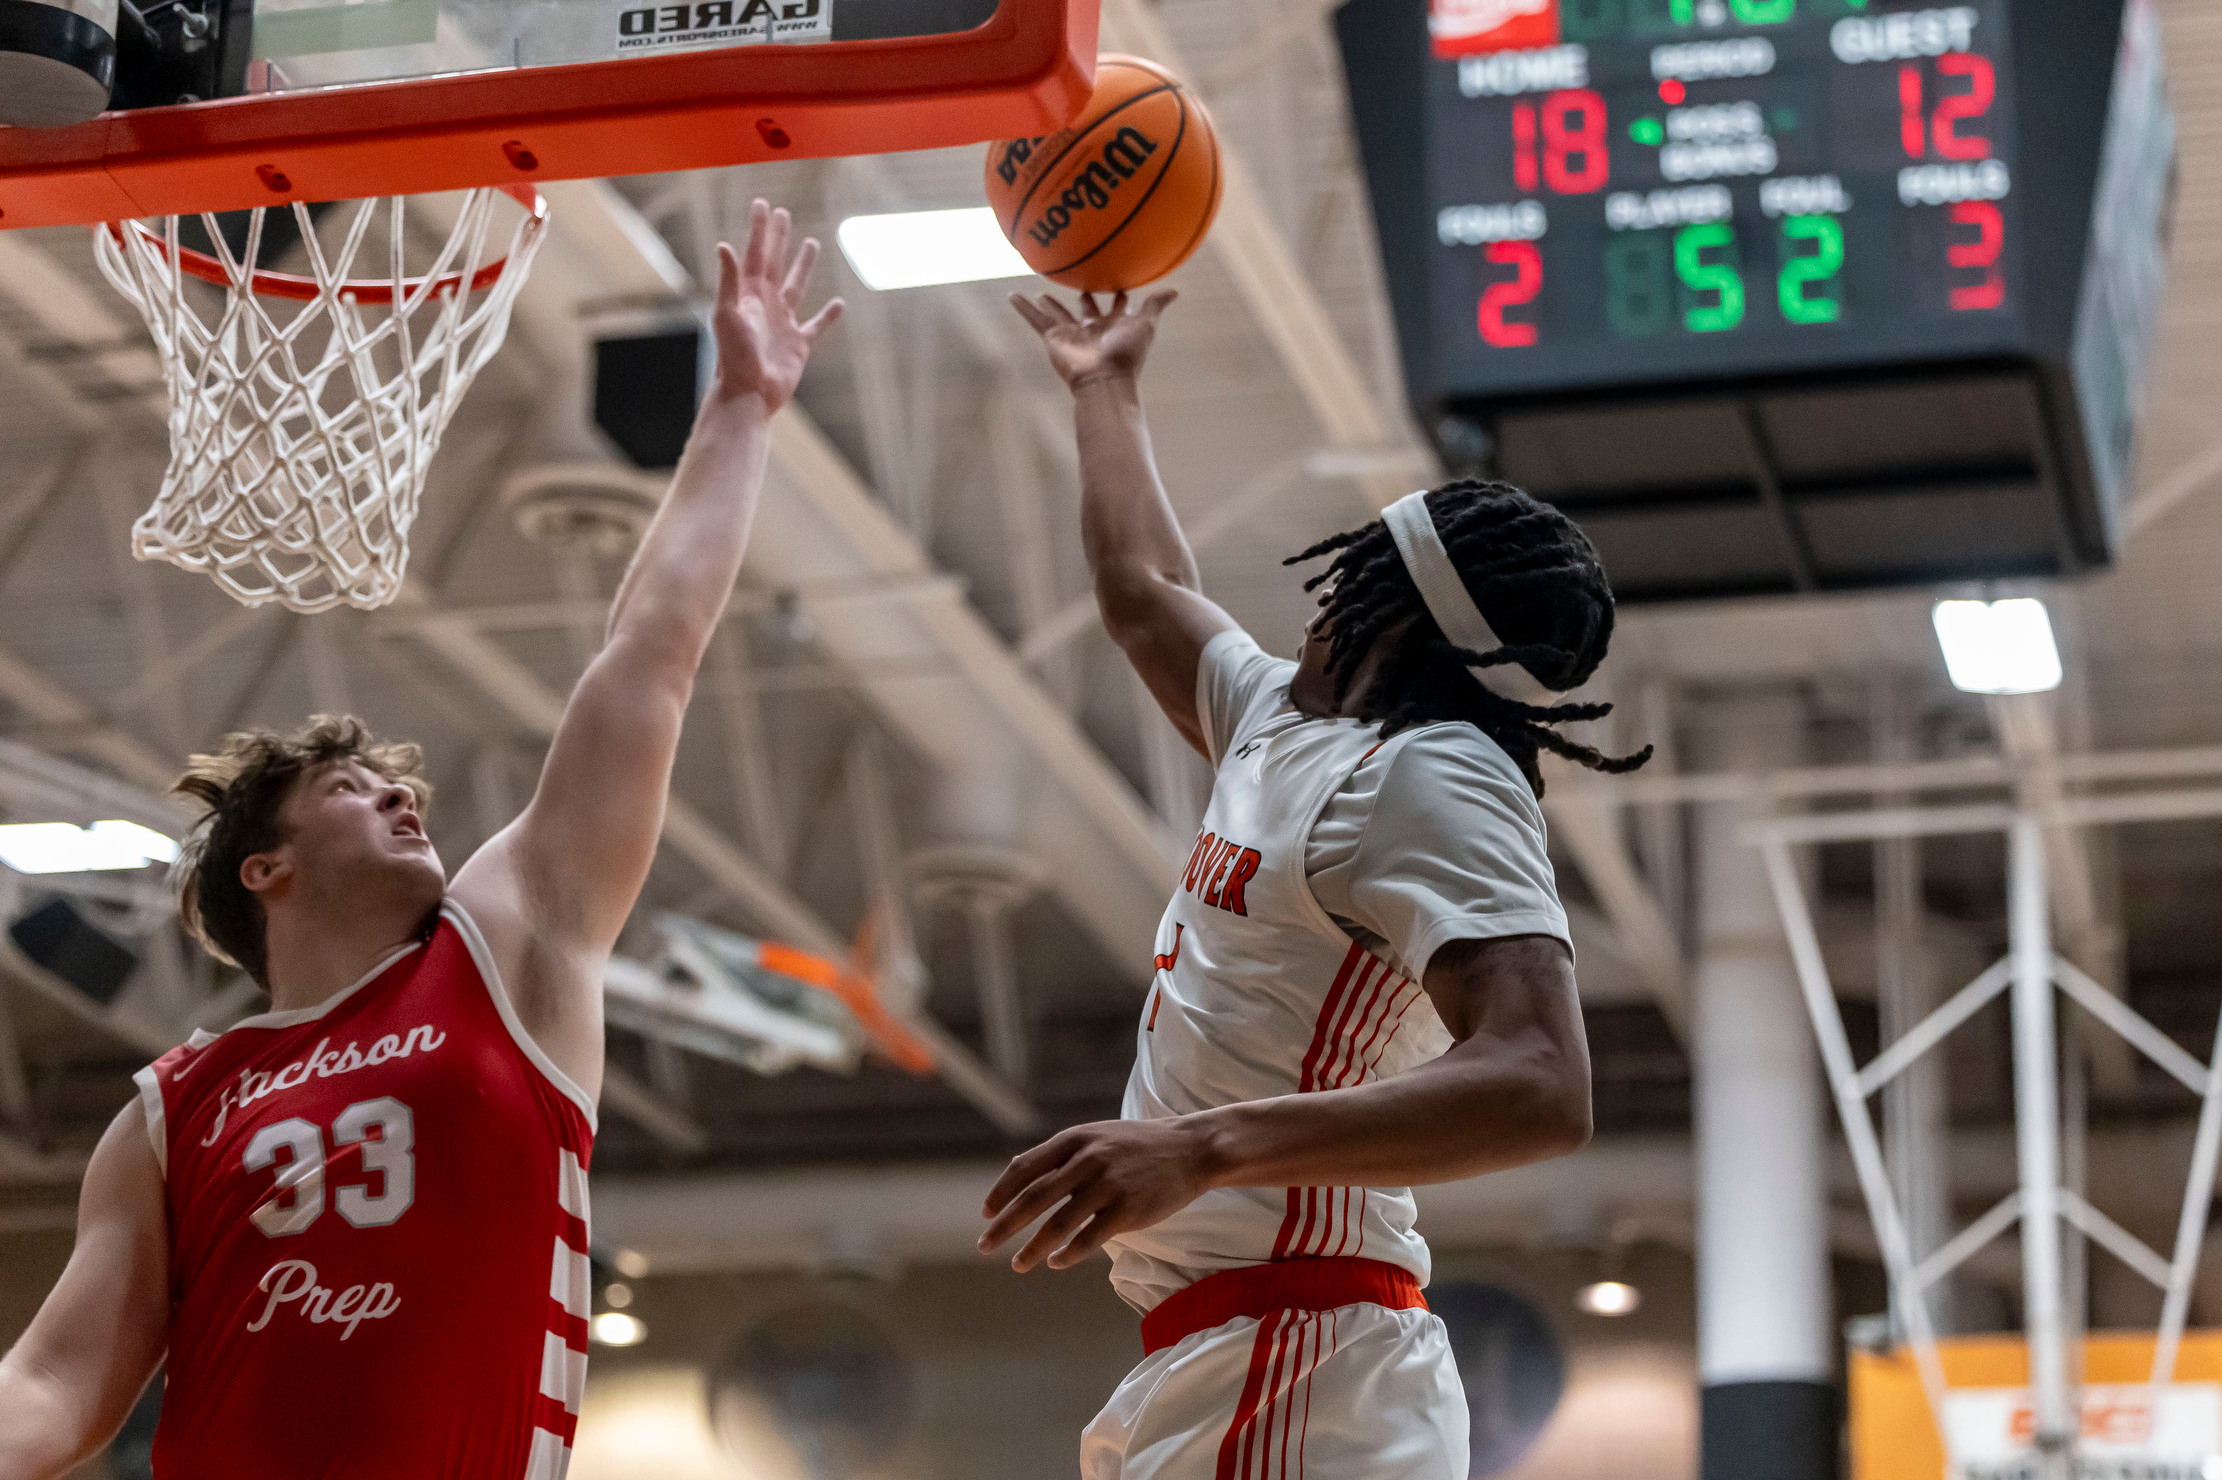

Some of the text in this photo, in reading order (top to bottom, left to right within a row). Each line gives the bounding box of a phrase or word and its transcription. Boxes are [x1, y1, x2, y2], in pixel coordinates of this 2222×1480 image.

[1458, 44, 1589, 97] HOME
[1830, 8, 1978, 63] GUEST
[1512, 88, 1609, 194] 18
[1900, 52, 1995, 160] 12
[1029, 126, 1158, 248] Wilson
[1478, 240, 1543, 347] 2
[1674, 224, 1744, 331] 5
[1777, 214, 1843, 324] 2
[1947, 201, 2005, 310] 3
[201, 1025, 446, 1147] Jackson
[242, 1096, 415, 1239] 33
[247, 1259, 401, 1341] Prep
